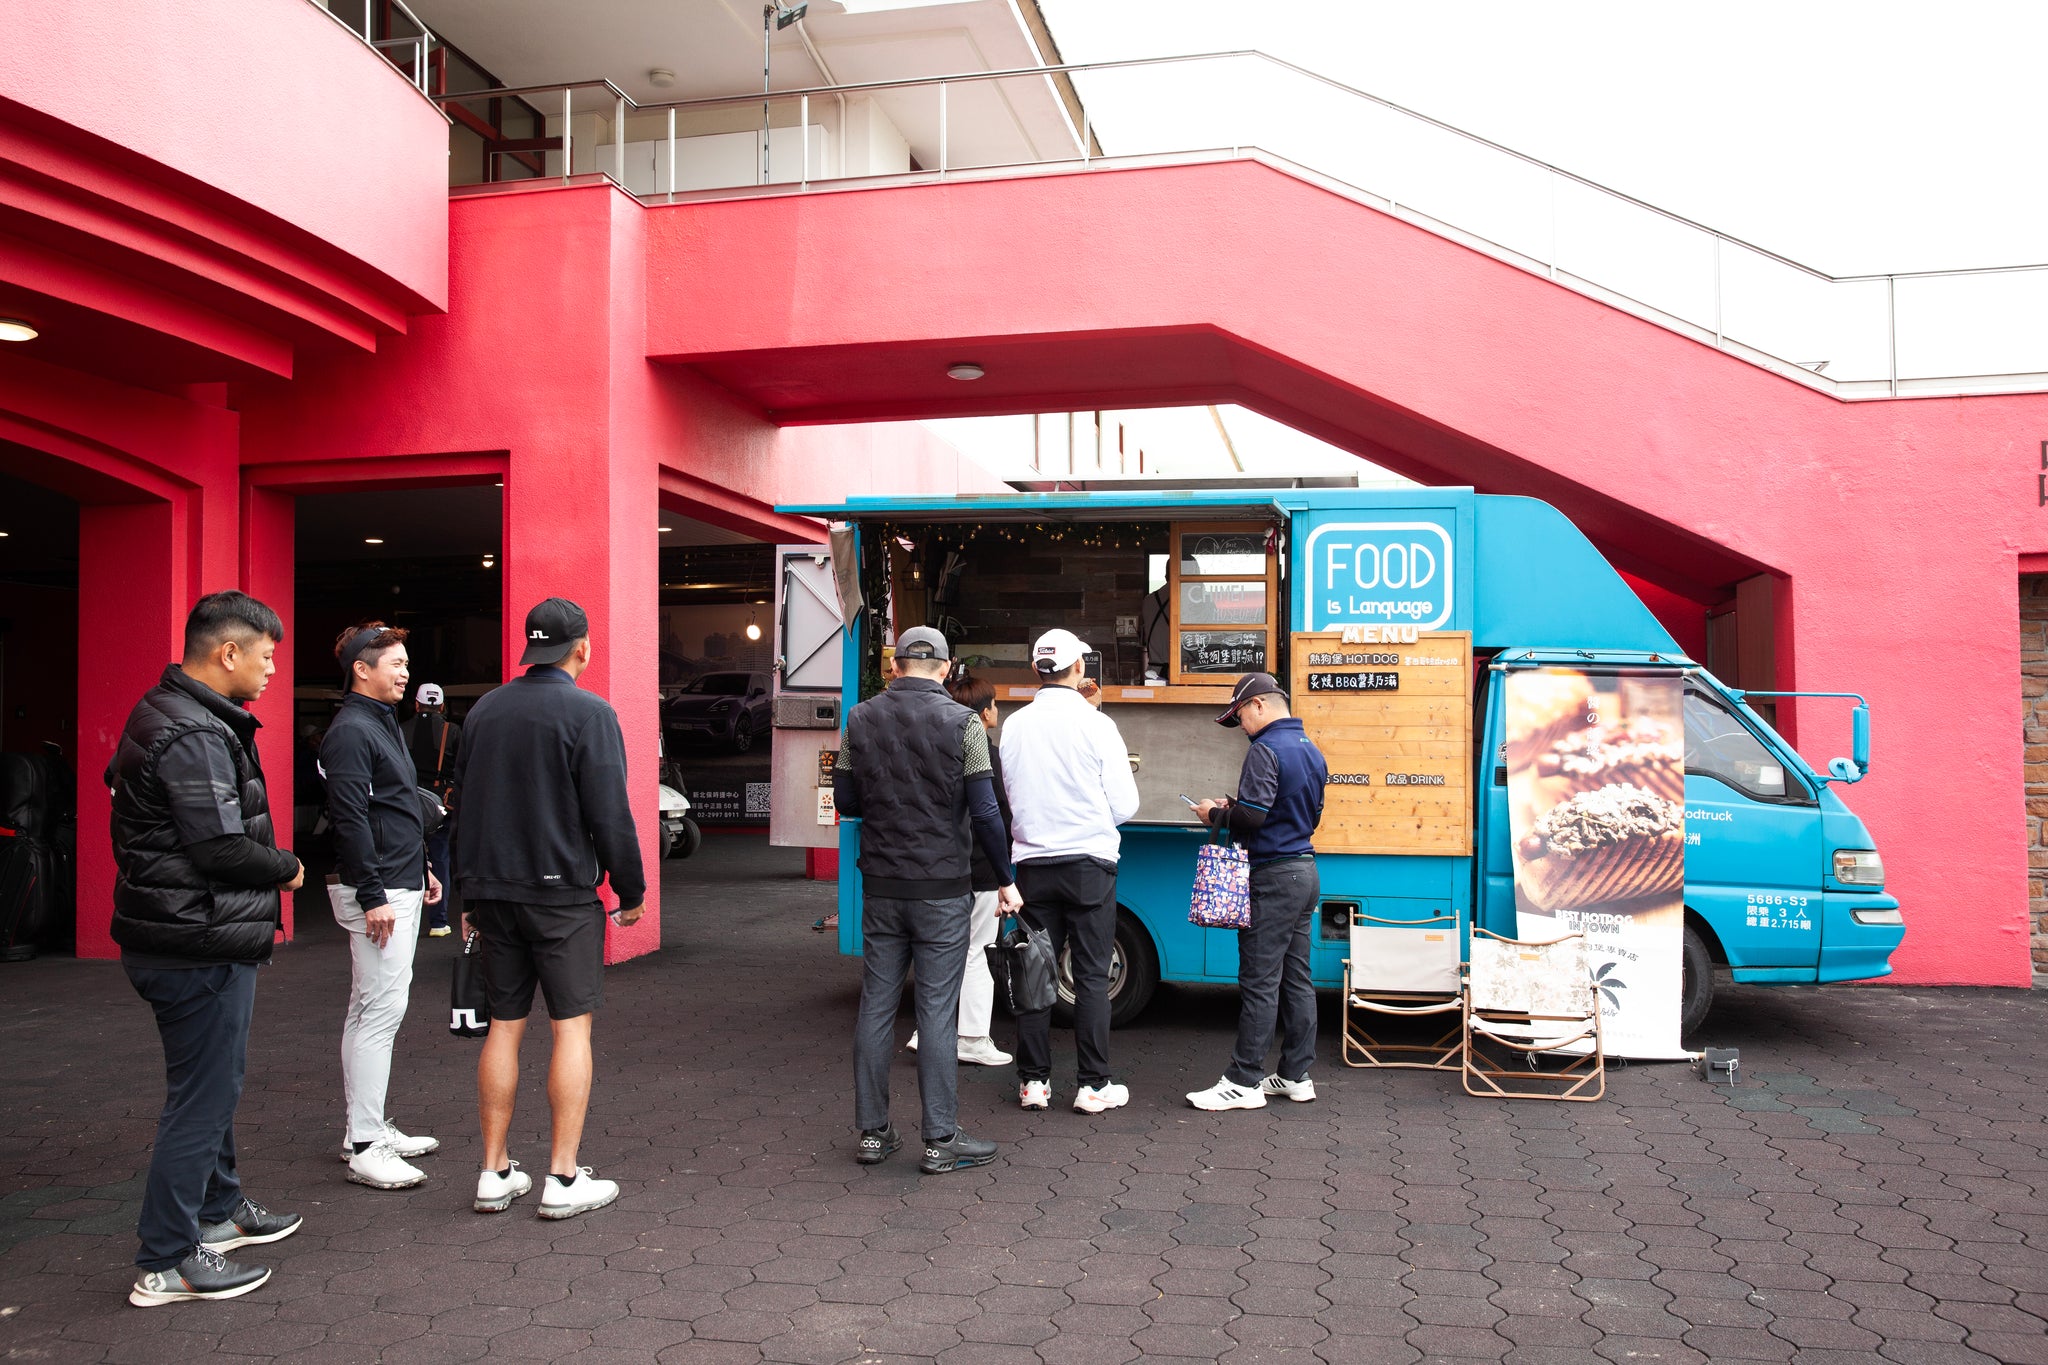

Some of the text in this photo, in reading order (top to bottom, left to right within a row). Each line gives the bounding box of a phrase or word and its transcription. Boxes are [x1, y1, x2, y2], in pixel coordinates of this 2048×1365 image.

[1328, 543, 1435, 589] FOOD
[1188, 585, 1245, 603] CHIMEI
[1342, 626, 1418, 643] MENU
[1310, 653, 1343, 665] 熱狗堡
[1346, 654, 1370, 664] HOT
[1373, 654, 1399, 664] DOG
[1333, 775, 1369, 784] SNACK
[1386, 773, 1444, 785] 飲品 DRINK
[1684, 809, 1733, 822] odtruck
[1747, 894, 1808, 907] 5686-S3
[1555, 909, 1580, 921] BEST
[1779, 908, 1787, 918] 3
[1795, 908, 1807, 919] 人
[1569, 920, 1620, 934] IN TOWN
